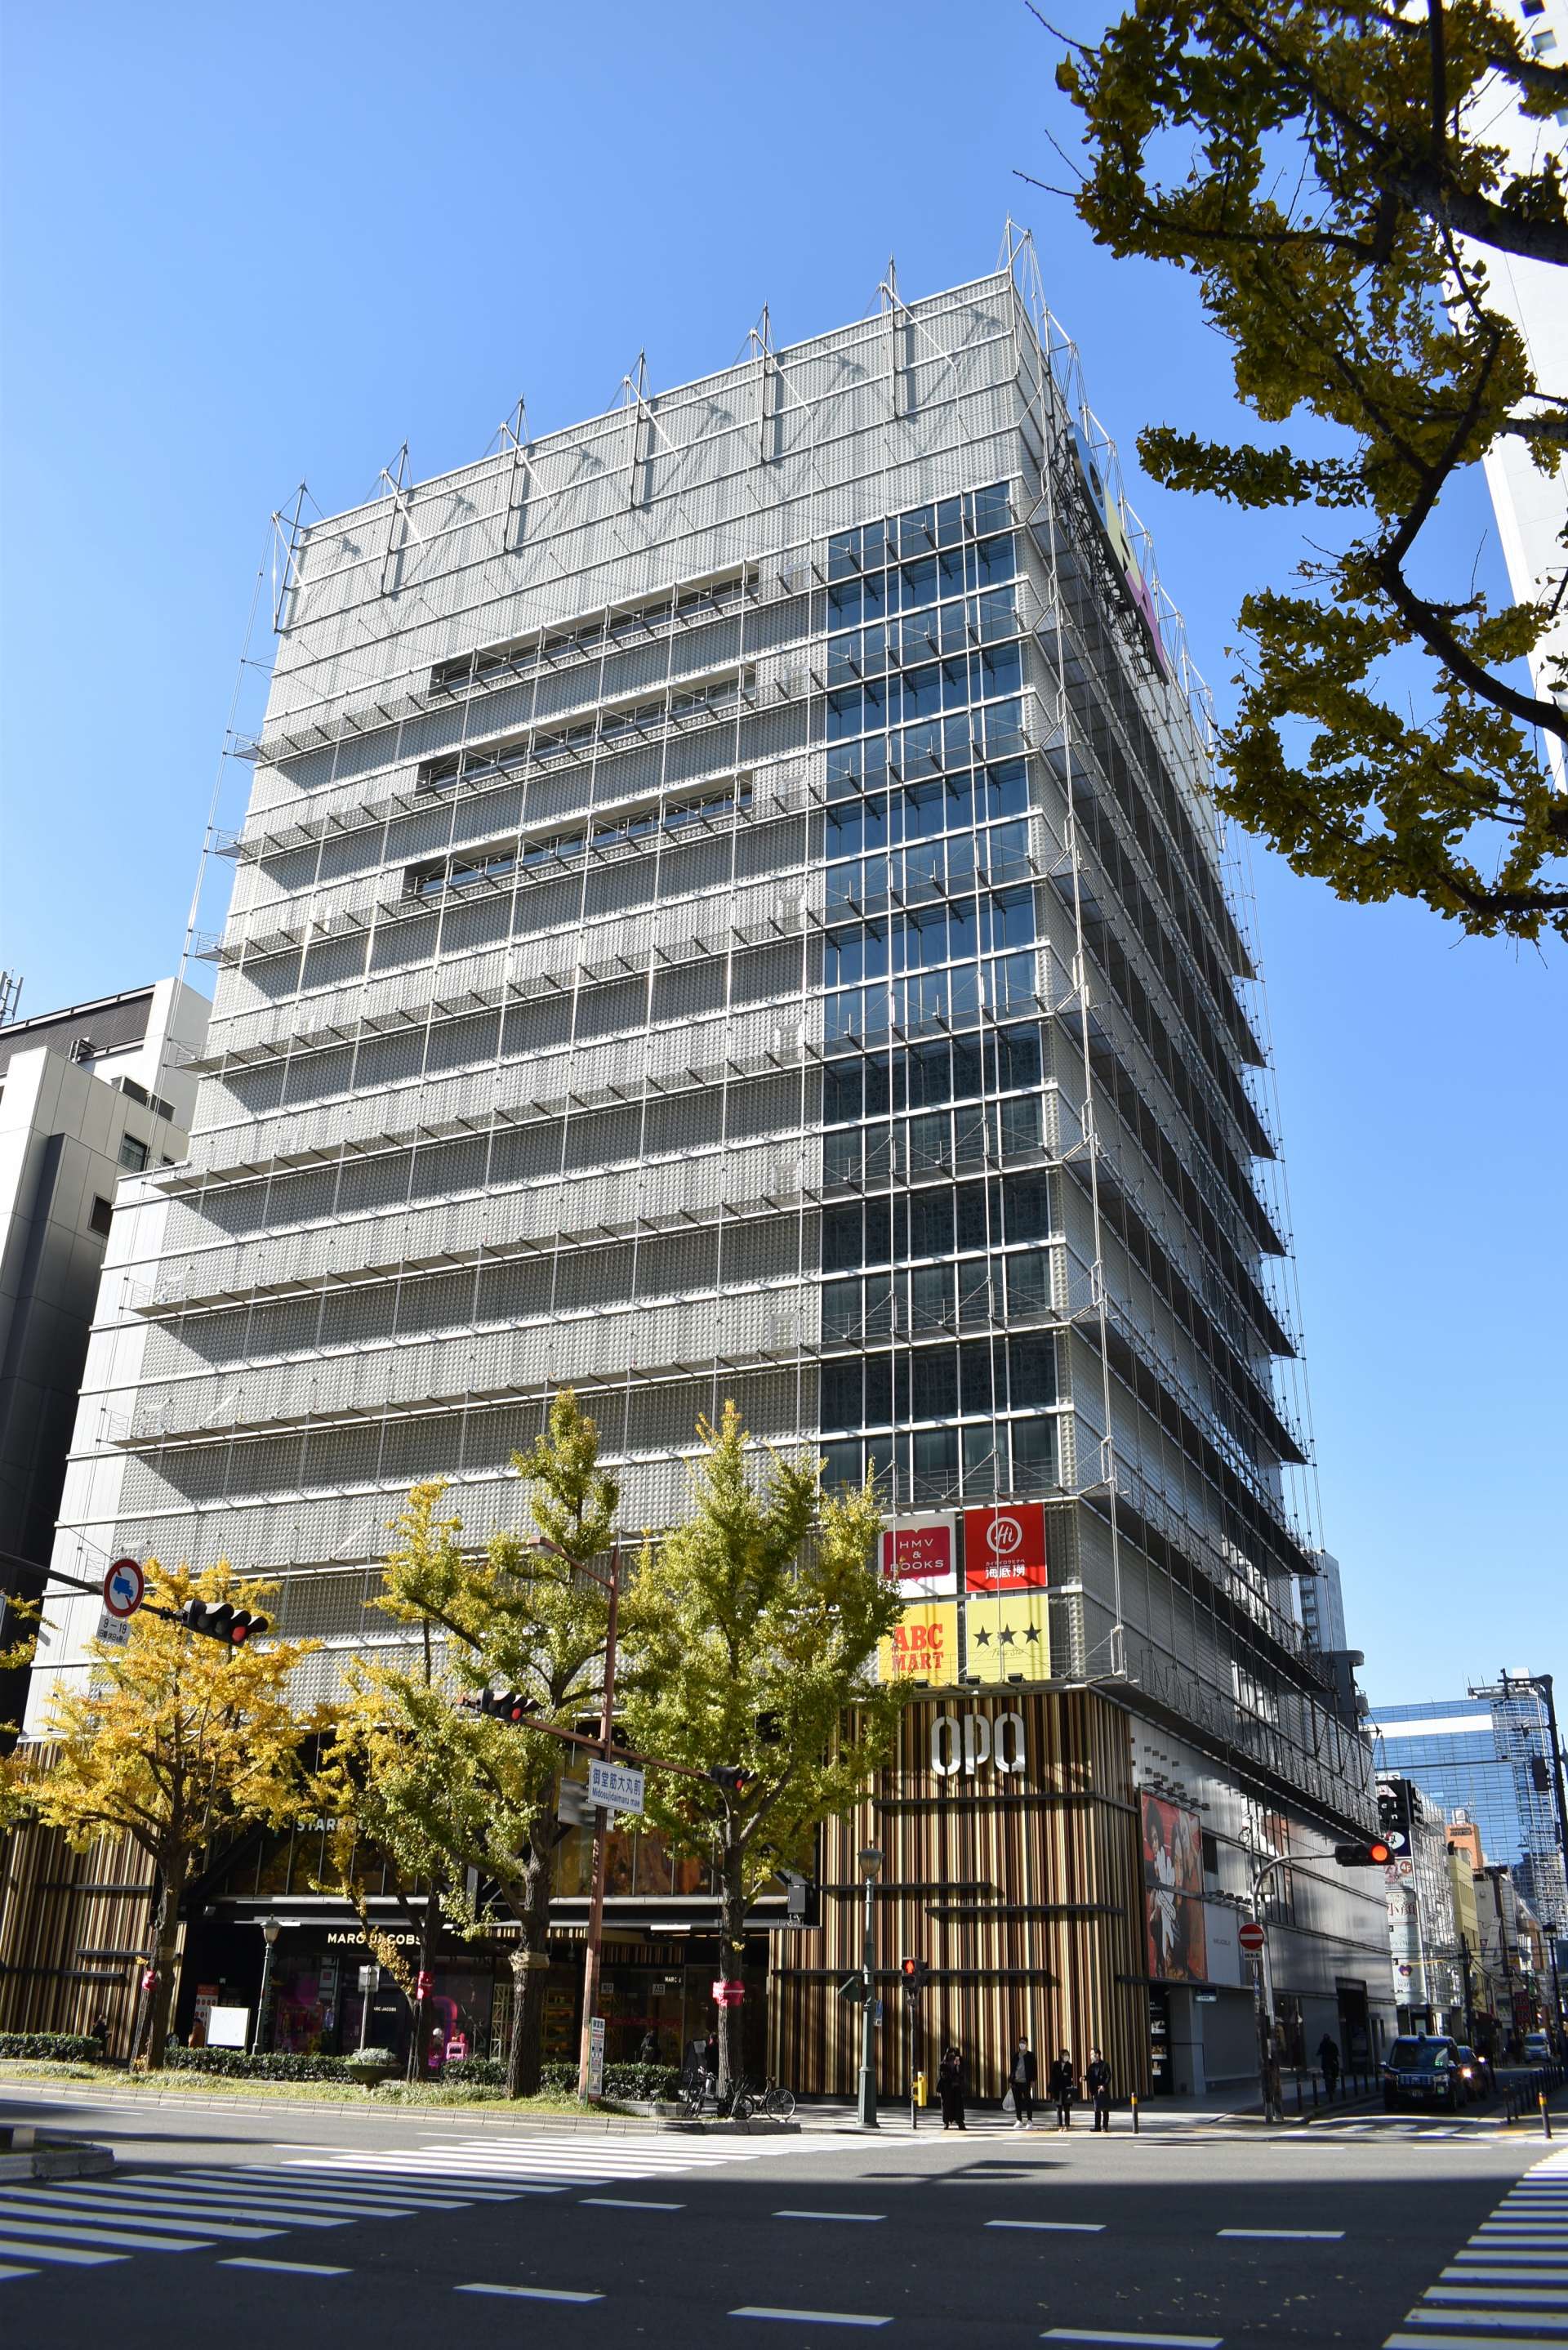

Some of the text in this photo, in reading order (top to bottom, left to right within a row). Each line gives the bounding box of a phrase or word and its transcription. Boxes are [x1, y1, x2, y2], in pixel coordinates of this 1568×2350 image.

[899, 1539, 933, 1550] HMV
[912, 1550, 922, 1559] &
[893, 1623, 943, 1652] ABC
[892, 1652, 944, 1673] MART
[593, 1768, 641, 1796] 御堂筋大丸前
